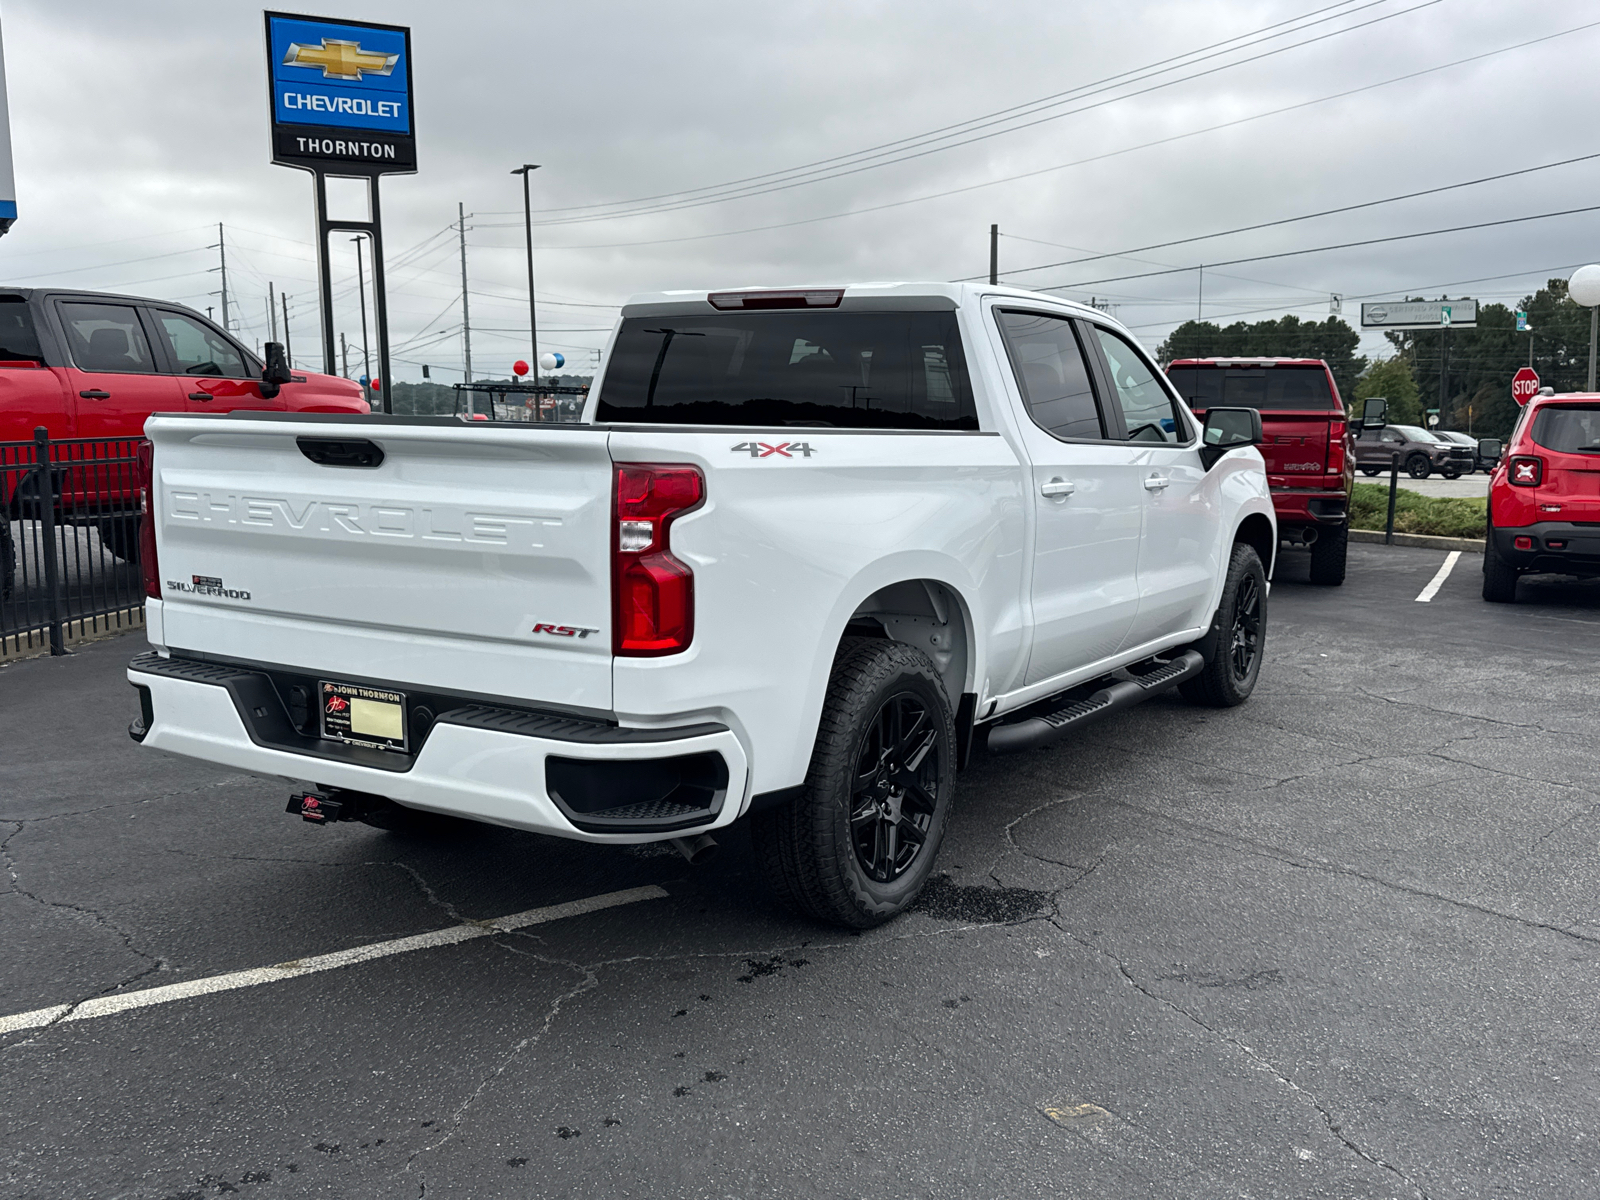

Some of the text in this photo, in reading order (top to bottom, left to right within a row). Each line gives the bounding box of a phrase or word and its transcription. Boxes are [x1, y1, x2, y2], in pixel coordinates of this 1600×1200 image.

[284, 92, 402, 118] CHEVROLET
[296, 137, 395, 159] THORNTON
[1514, 381, 1538, 395] STOP
[170, 491, 563, 548] CHEVROLET
[166, 580, 252, 600] SILVERADO
[532, 623, 600, 639] RST
[337, 685, 400, 702] JOHN THORNTON
